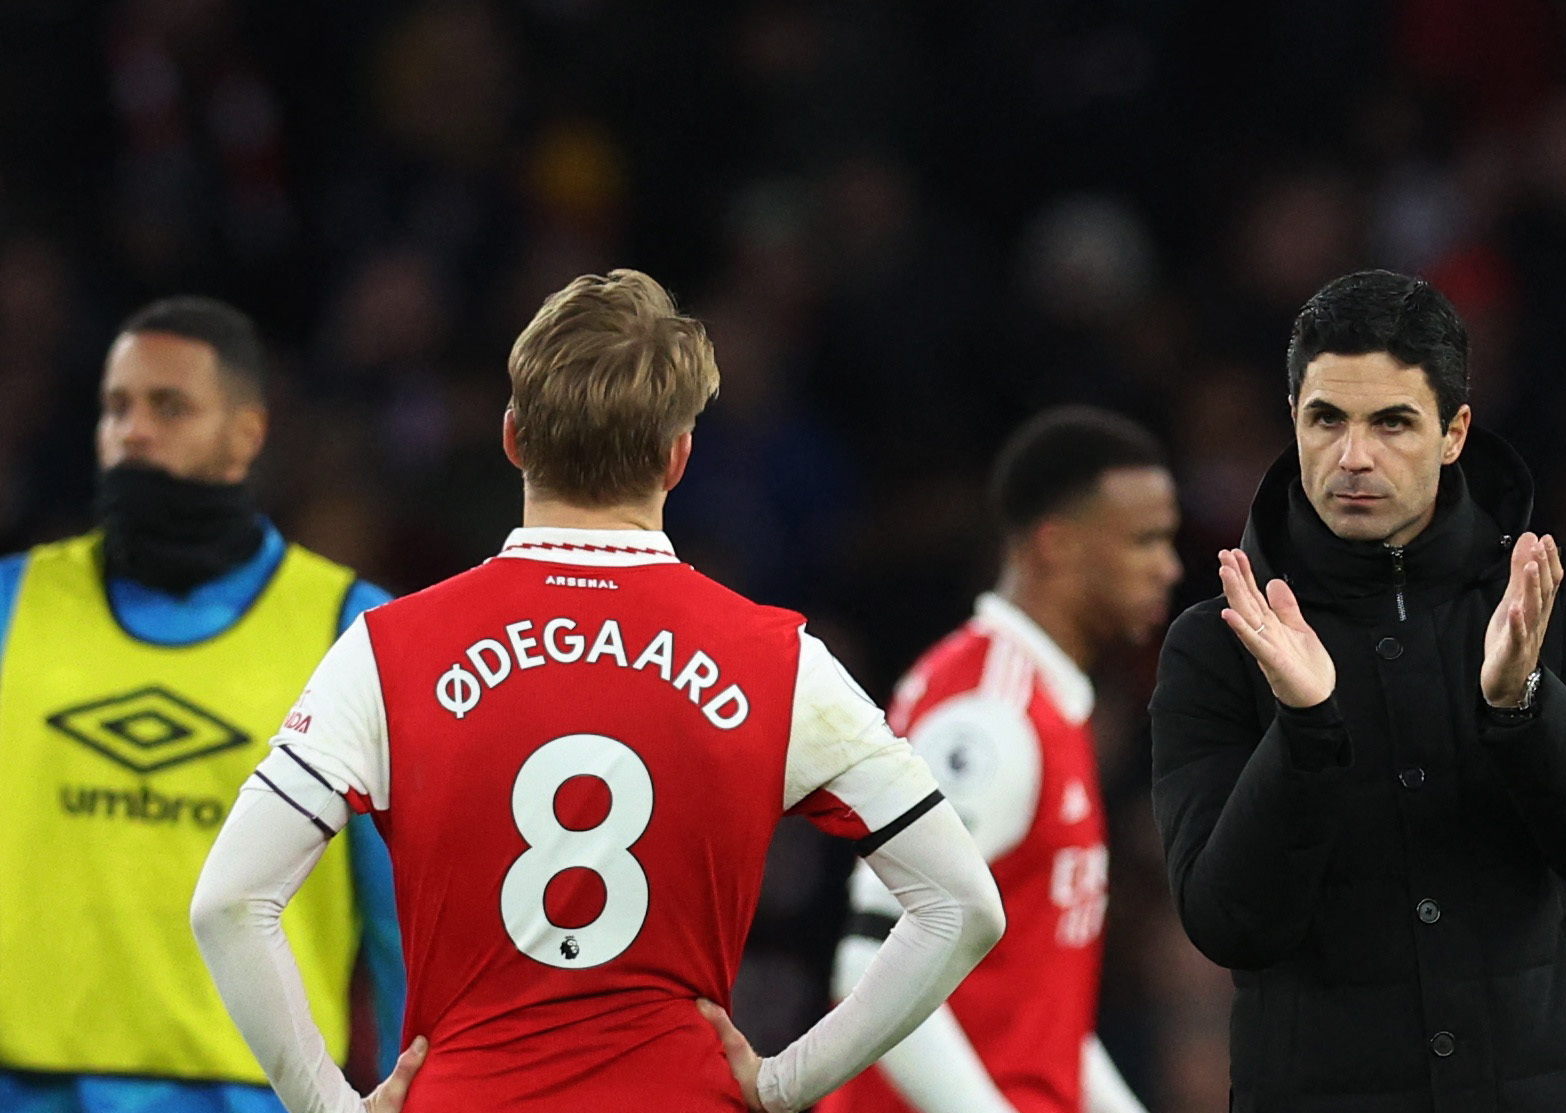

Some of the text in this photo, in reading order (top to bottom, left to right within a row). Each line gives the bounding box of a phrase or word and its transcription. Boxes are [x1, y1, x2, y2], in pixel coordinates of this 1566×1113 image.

[545, 575, 619, 590] ARSENAL
[435, 617, 750, 730] ØDEGAARD
[60, 785, 223, 827] umbro
[500, 733, 655, 970] 8
